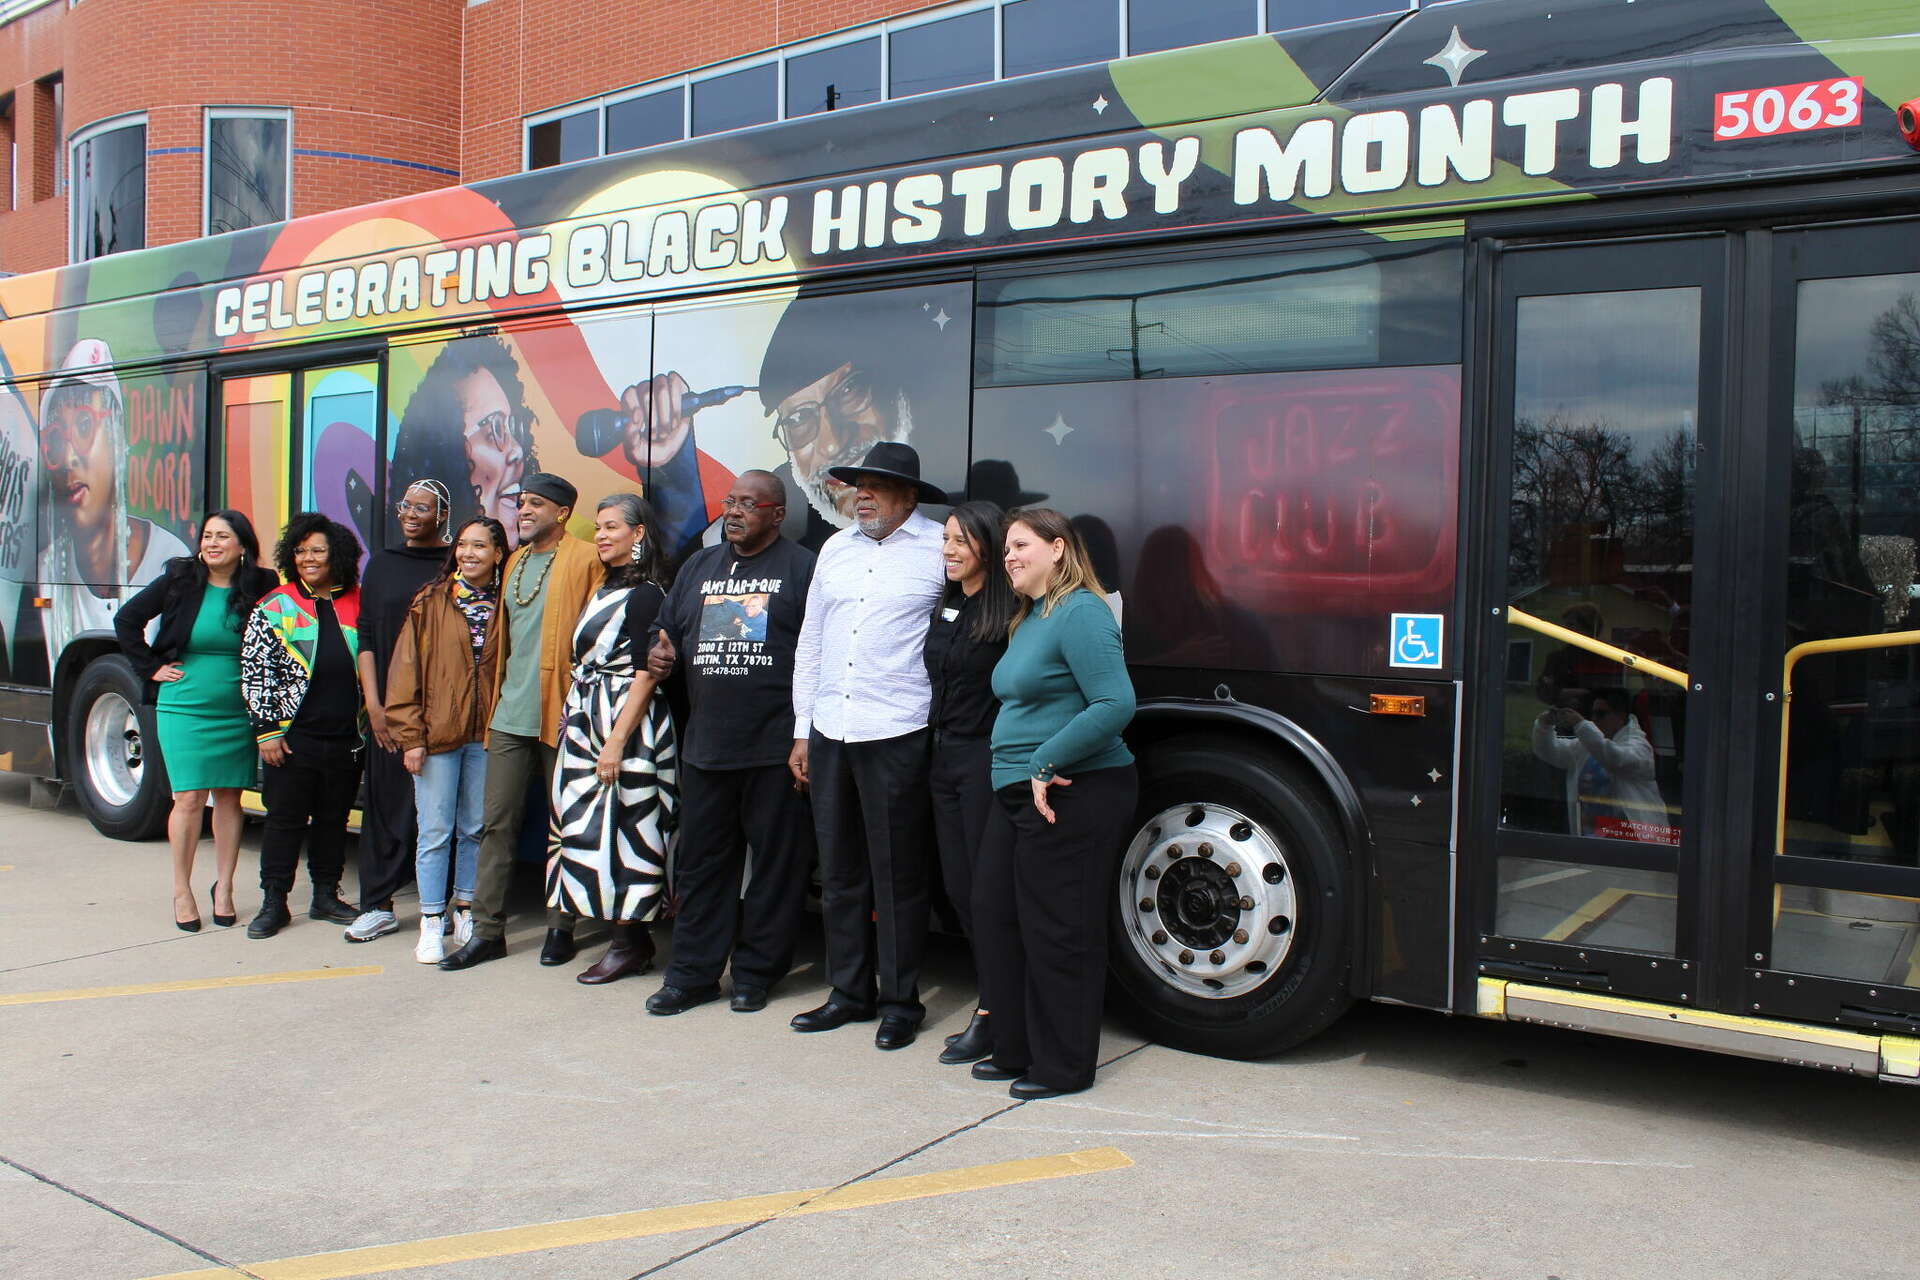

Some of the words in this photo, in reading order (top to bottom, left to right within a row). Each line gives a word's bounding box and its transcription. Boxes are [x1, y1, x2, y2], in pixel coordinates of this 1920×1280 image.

[1716, 79, 1860, 138] 5063
[214, 234, 552, 338] CELEBRATING
[566, 195, 790, 290] BLACK
[811, 136, 1201, 256] HISTORY
[1233, 76, 1674, 206] MONTH
[128, 383, 194, 446] DAWN
[1246, 402, 1409, 478] JAZZ
[128, 449, 191, 524] OKORO
[1239, 478, 1396, 562] CLUB
[726, 578, 783, 593] BAR-B-QUE
[697, 642, 716, 653] 2000
[728, 641, 750, 653] 12TH
[752, 642, 764, 653] ST
[702, 666, 749, 676] 512-478-0378
[725, 654, 739, 665] TX
[743, 655, 773, 666] 78702
[1649, 824, 1671, 835] YOUR
